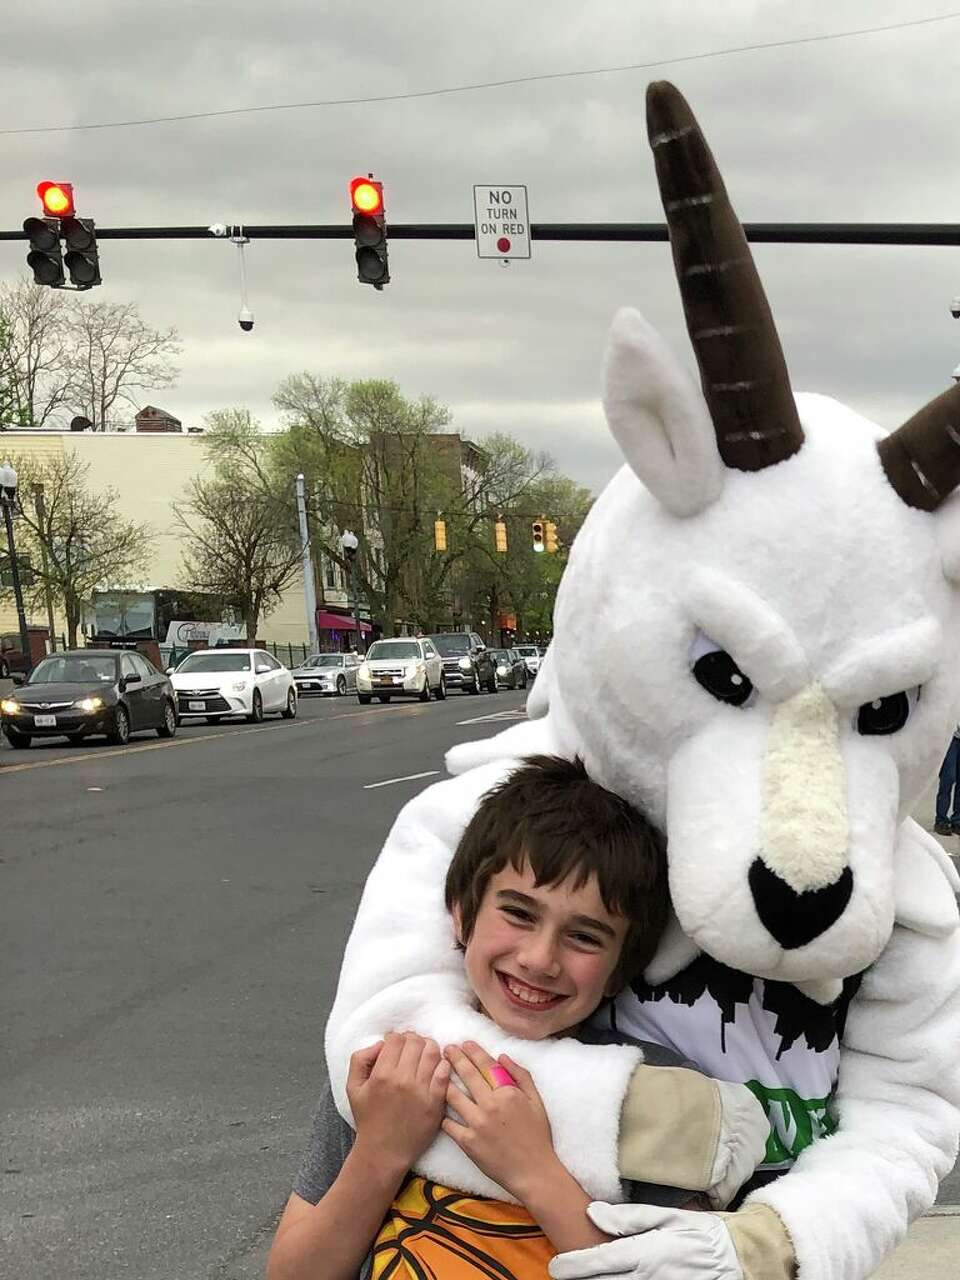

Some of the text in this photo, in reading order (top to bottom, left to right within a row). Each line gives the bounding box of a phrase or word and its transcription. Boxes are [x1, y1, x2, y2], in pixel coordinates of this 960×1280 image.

[489, 190, 512, 204] NO
[487, 208, 517, 220] TURN
[481, 223, 525, 235] ON RED
